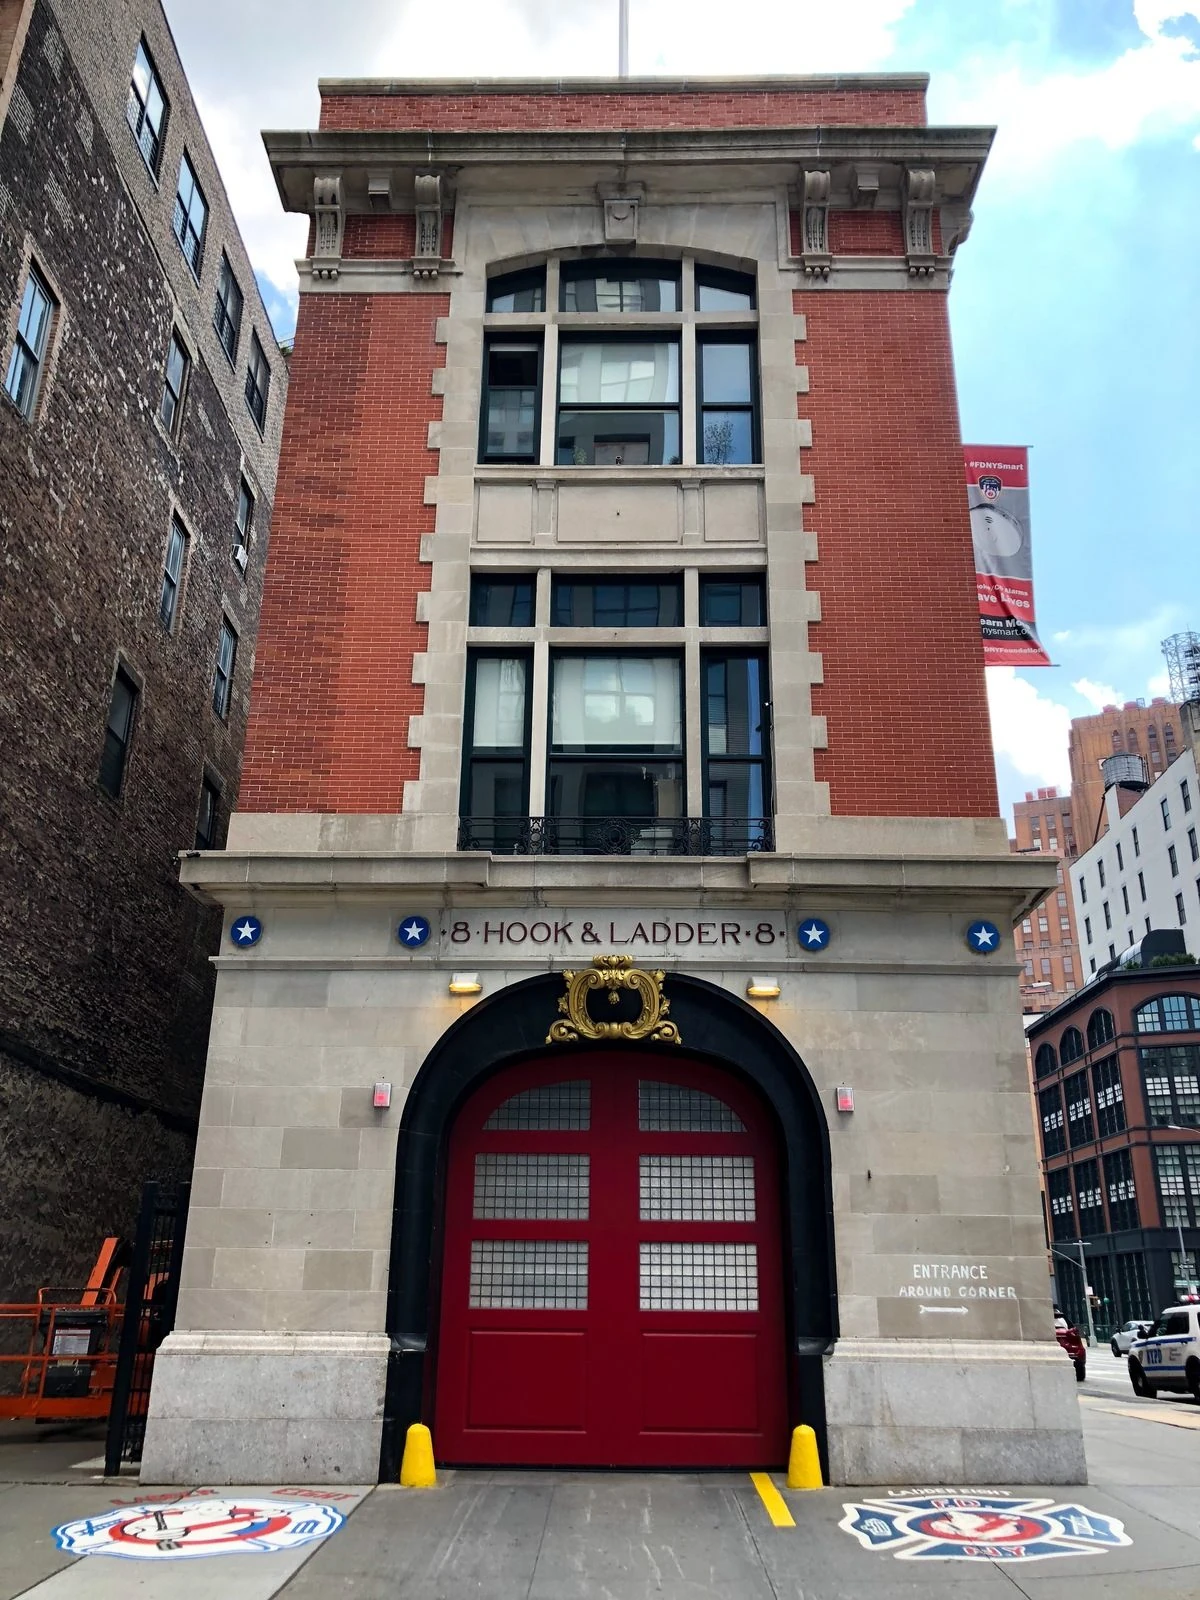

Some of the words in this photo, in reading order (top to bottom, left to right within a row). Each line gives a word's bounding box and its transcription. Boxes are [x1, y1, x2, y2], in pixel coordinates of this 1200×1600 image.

[969, 461, 1024, 470] #FDNYSmart
[977, 593, 997, 603] ave
[1000, 592, 1030, 608] Lives
[980, 618, 1003, 628] earn
[451, 921, 471, 944] 8
[484, 921, 574, 944] HOOK
[609, 921, 742, 945] LADDER
[755, 922, 776, 945] 8
[913, 1264, 988, 1279] ENTRANCE
[899, 1285, 952, 1298] AROUND
[958, 1286, 1017, 1299] CORNER
